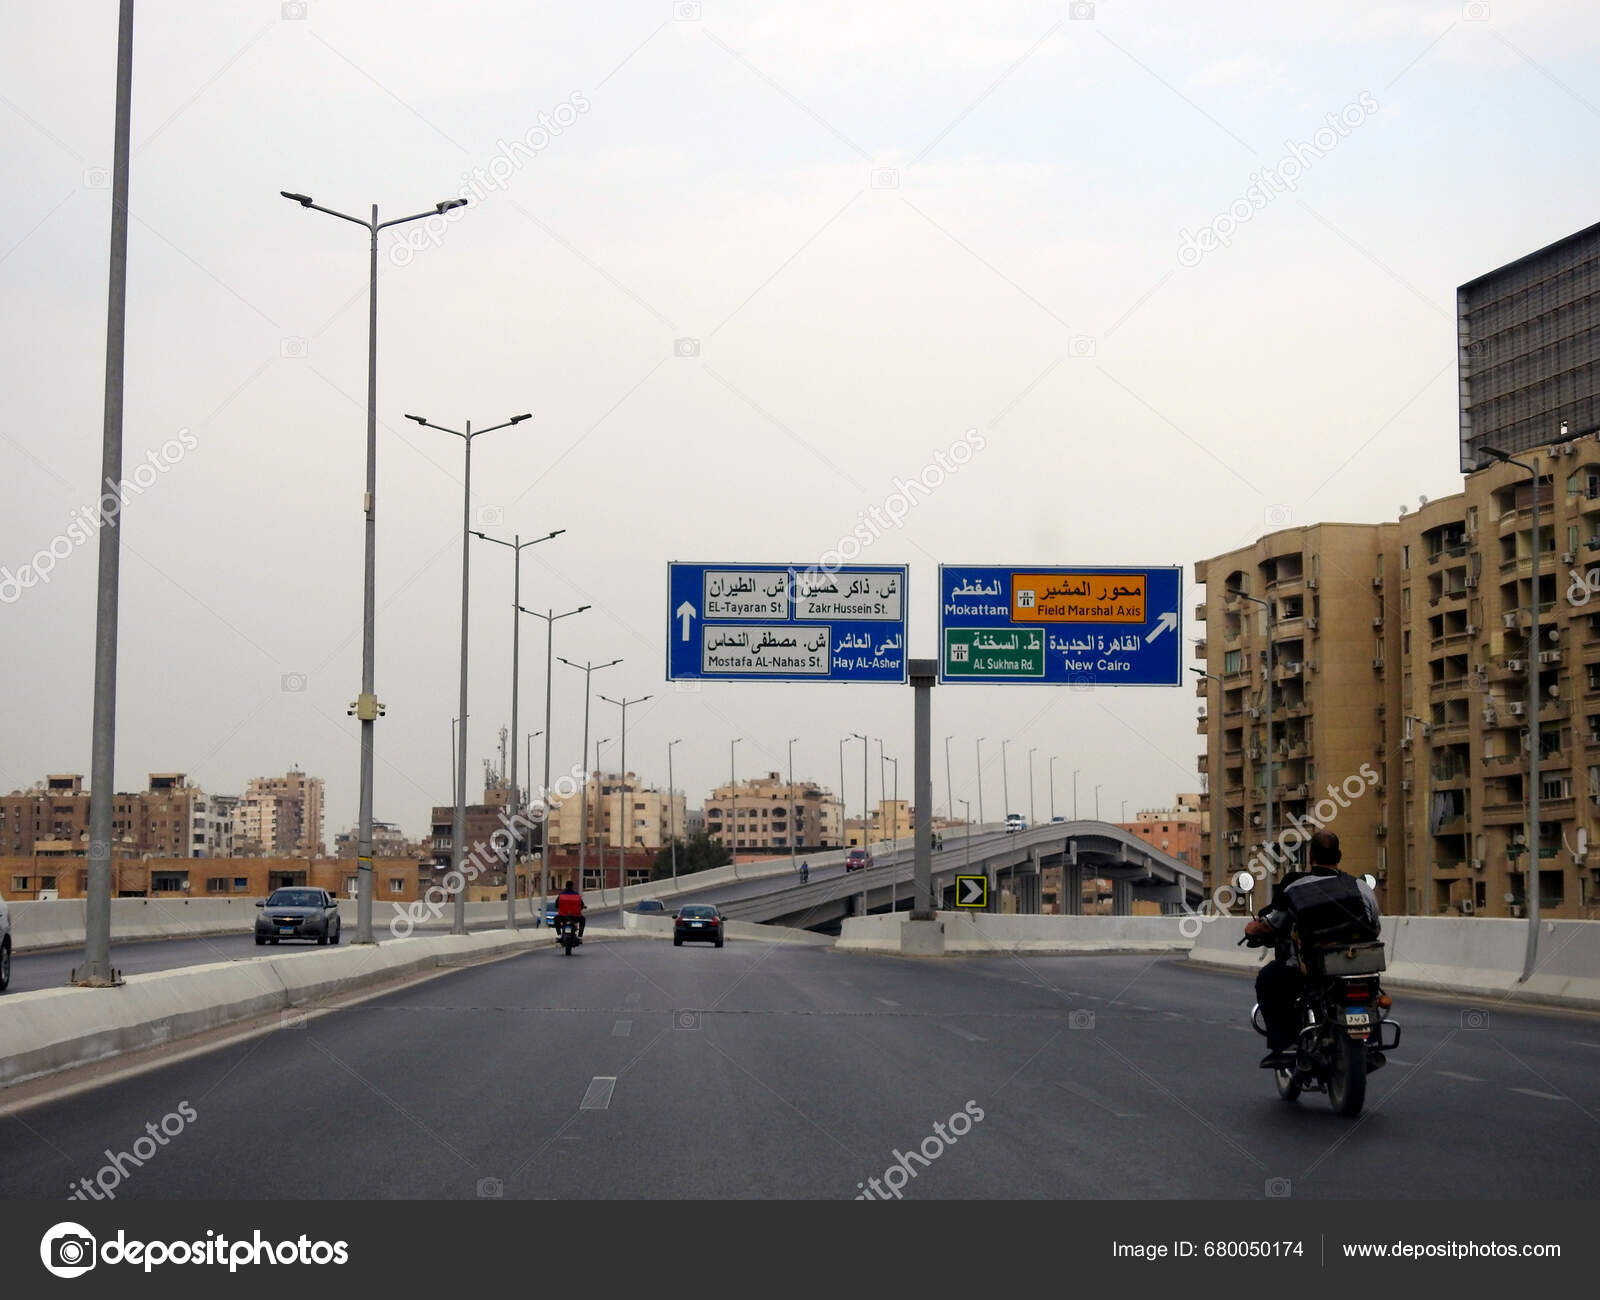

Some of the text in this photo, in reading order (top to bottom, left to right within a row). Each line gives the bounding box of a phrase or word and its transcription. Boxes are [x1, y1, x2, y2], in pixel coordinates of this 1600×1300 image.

[710, 577, 755, 597] الطيران
[844, 580, 870, 598] ذاكر
[952, 578, 1001, 601] المقطم
[1040, 580, 1141, 600] محور المشير
[709, 602, 784, 615] EL-Tayaran St.
[809, 603, 888, 614] Zakr Hussein St.
[945, 604, 1008, 615] Mokattam
[1037, 605, 1140, 616] Field Marshal Axis
[708, 632, 749, 650] النحاس
[833, 633, 870, 653] العاشر
[972, 632, 1019, 650] السخنة
[1049, 635, 1140, 655] القاهرة الجديدة
[709, 656, 823, 668] Mostafa AL-Nahas St.
[833, 657, 900, 670] Hay AL-Asher
[973, 658, 1034, 670] AL Sukhna Rd.
[1065, 660, 1130, 671] New Cairo
